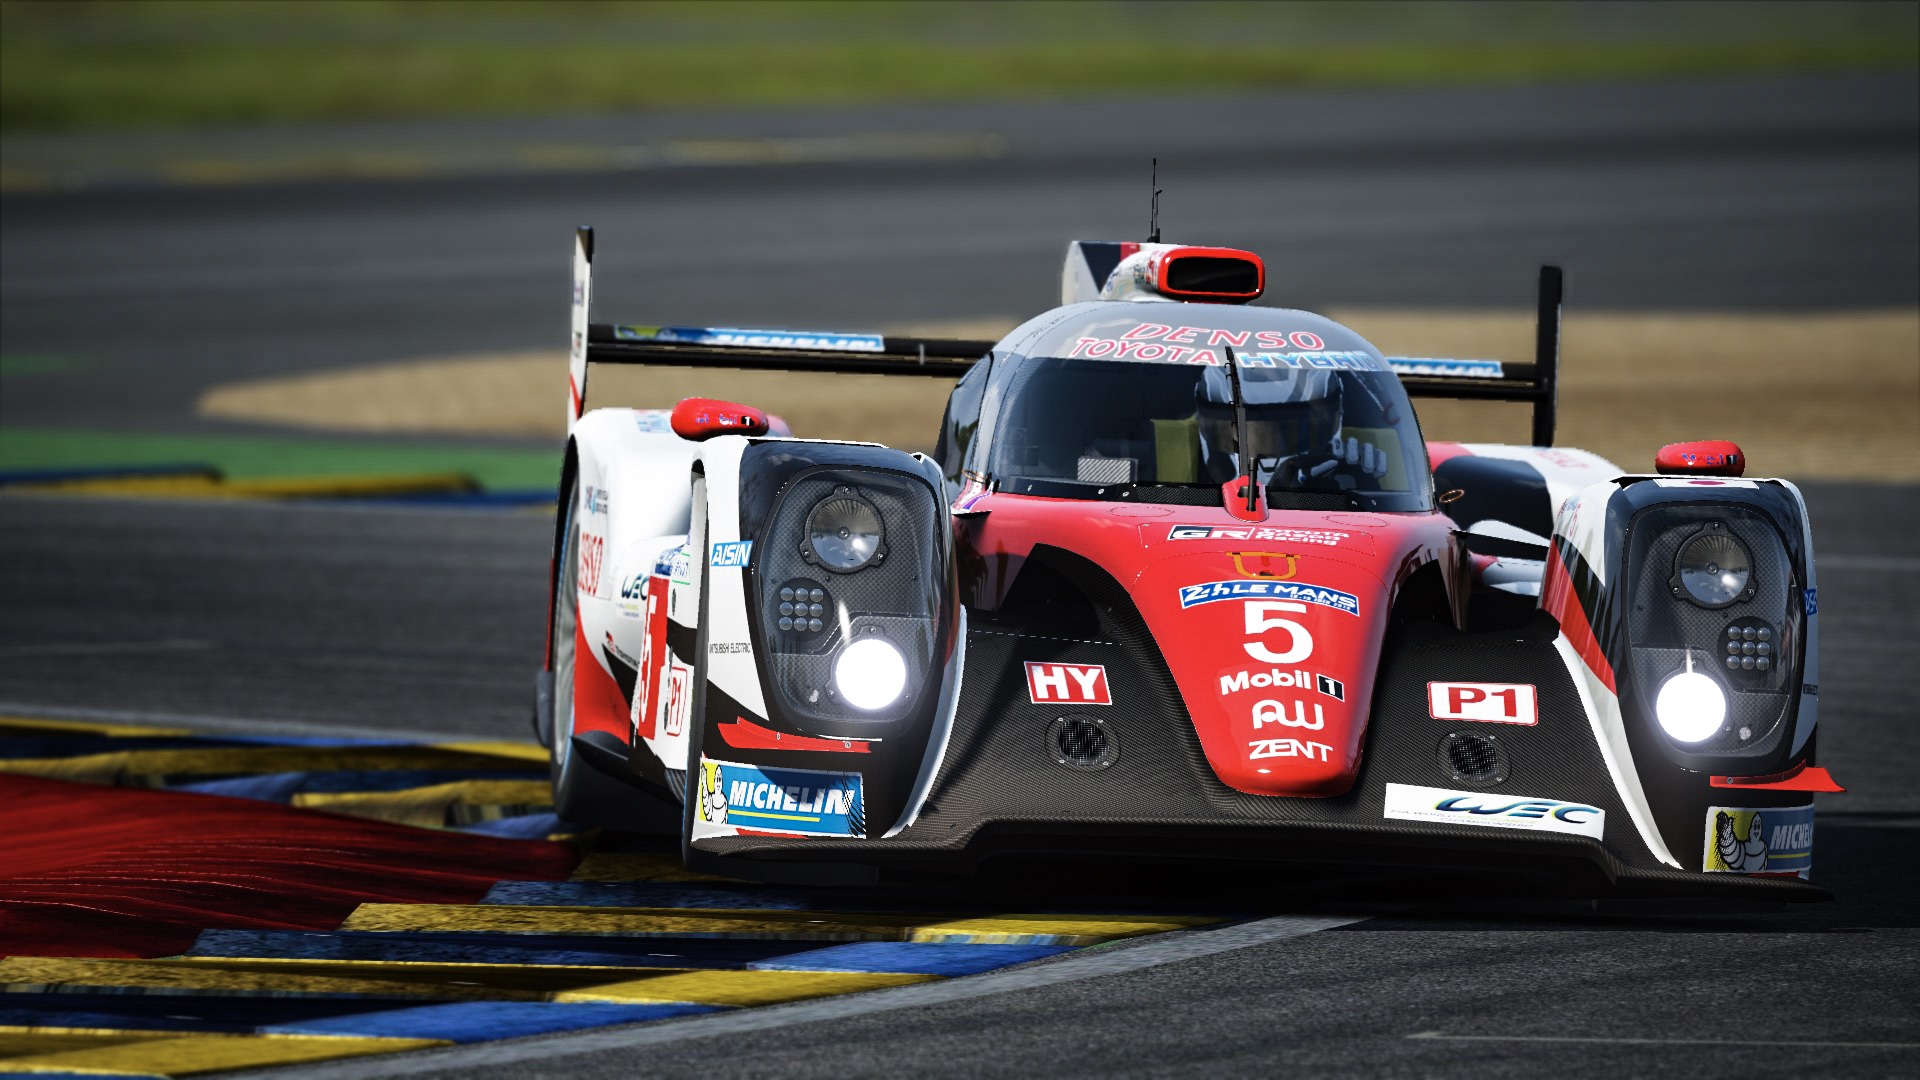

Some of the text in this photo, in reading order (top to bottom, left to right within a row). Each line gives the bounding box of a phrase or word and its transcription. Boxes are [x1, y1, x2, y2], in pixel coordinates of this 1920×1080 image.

[1120, 322, 1325, 351] DENSO
[1068, 336, 1217, 366] TOYOTA
[1235, 350, 1381, 371] HYBRID
[1172, 529, 1249, 539] GR
[711, 543, 751, 565] AISIN
[621, 573, 650, 600] WEC
[1232, 585, 1269, 593] LE
[1274, 585, 1356, 608] MANS
[1243, 601, 1314, 664] 5
[731, 643, 751, 653] ELECTRIC
[1031, 665, 1102, 700] HY
[1220, 669, 1311, 695] Mobil
[670, 677, 682, 725] P1
[1448, 687, 1517, 717] P1
[1249, 739, 1333, 762] ZENT
[729, 780, 854, 815] MICHELIN
[1433, 797, 1600, 824] WEC
